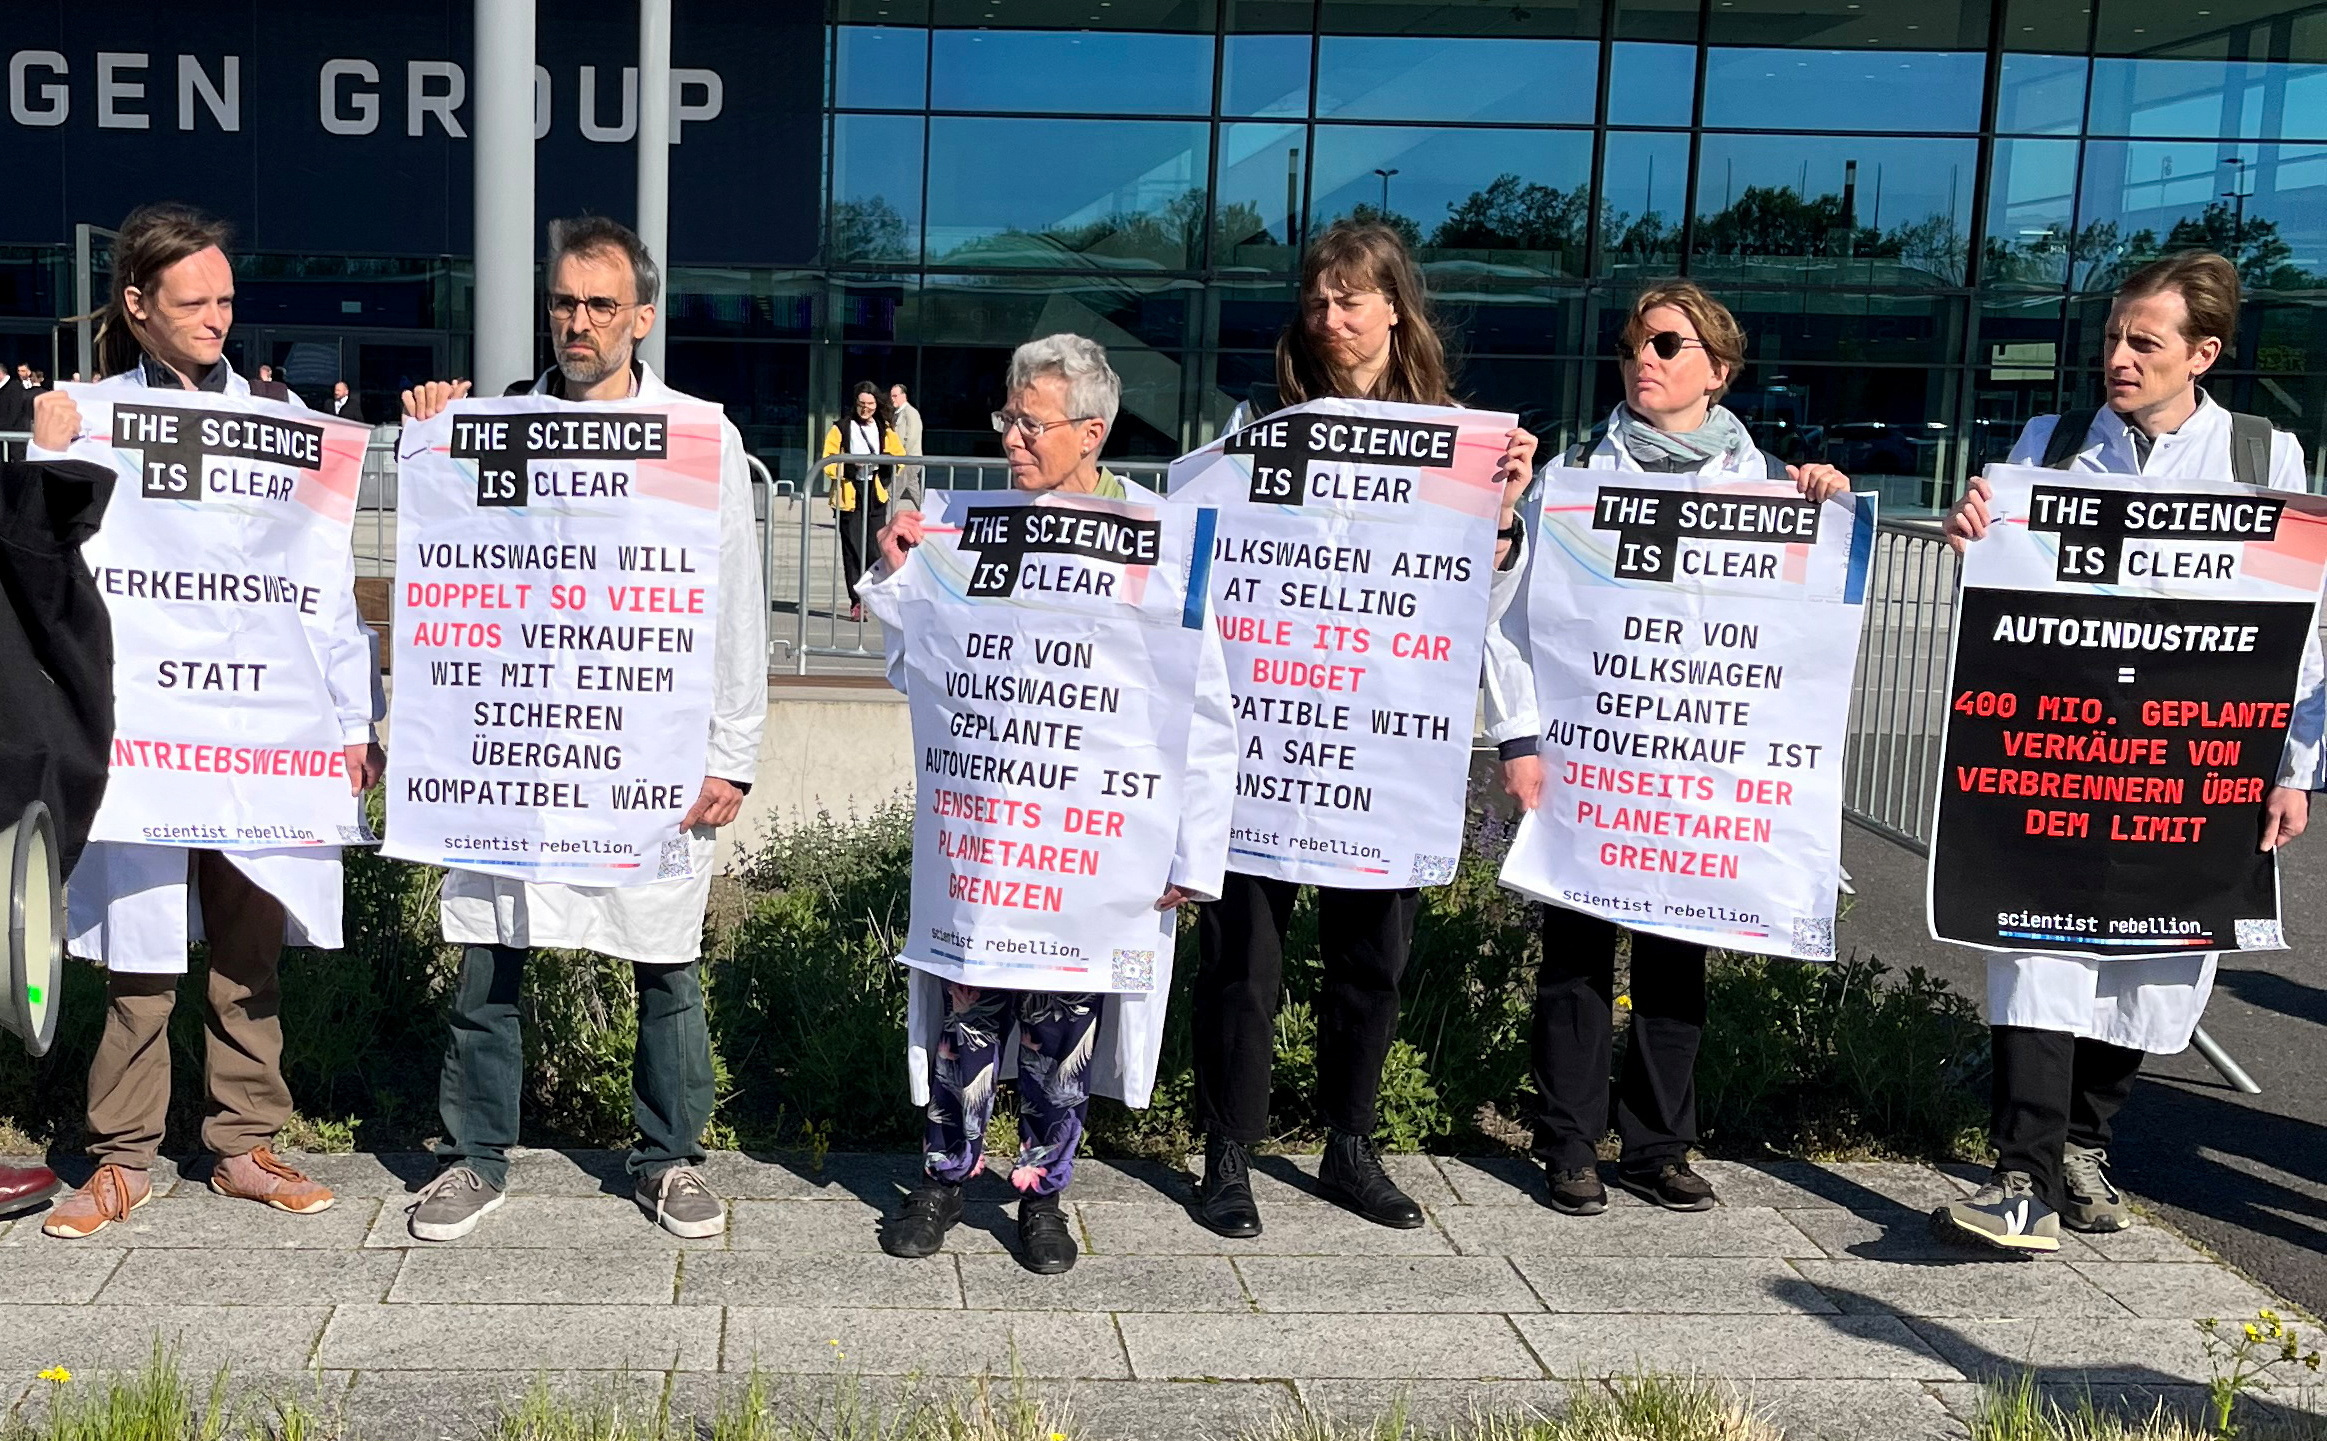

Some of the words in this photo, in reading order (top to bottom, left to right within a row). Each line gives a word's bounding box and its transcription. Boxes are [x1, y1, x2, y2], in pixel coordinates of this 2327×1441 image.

[10, 51, 239, 131] GEN
[117, 412, 178, 443] THE
[202, 419, 318, 462] SCIENCE
[457, 423, 508, 450] THE
[527, 422, 662, 450] SCIENCE
[1234, 421, 1288, 449] THE
[1309, 423, 1451, 458] SCIENCE
[148, 462, 187, 491] IS
[210, 468, 293, 501] CLEAR
[483, 471, 515, 498] IS
[535, 472, 628, 496] CLEAR
[1255, 468, 1291, 495] IS
[1312, 473, 1411, 503] CLEAR
[1602, 496, 1659, 524] THE
[1679, 502, 1815, 535] SCIENCE
[2036, 495, 2101, 525] THE
[2125, 502, 2276, 532] SCIENCE
[969, 517, 1009, 543] THE
[1026, 515, 1155, 558] SCIENCE
[419, 544, 596, 569] VOLKSWAGEN
[619, 546, 695, 572] WILL
[1215, 538, 1370, 573] LKSWAGEN
[1392, 552, 1471, 581] AIMS
[1621, 544, 1661, 572] IS
[1683, 550, 1777, 579] CLEAR
[2063, 546, 2105, 574] IS
[2129, 551, 2234, 579] CLEAR
[95, 566, 321, 616] ERKEHRSWEE
[408, 583, 531, 608] DOPPELT
[551, 585, 585, 610] SO
[608, 586, 704, 613] VIELE
[974, 564, 1008, 589] IS
[1022, 564, 1114, 596] CLEAR
[1224, 578, 1261, 602] AT
[1280, 582, 1416, 617] SELLING
[414, 623, 501, 648] AUTOS
[521, 624, 692, 652] VERKAUFEN
[967, 633, 1013, 660] DER
[1035, 639, 1092, 668] VON
[1216, 615, 1292, 645] UBLE
[1314, 625, 1370, 653] ITS
[1393, 633, 1451, 661] CAR
[1624, 616, 1683, 644] DER
[1704, 623, 1758, 649] VON
[1993, 615, 2258, 651] AUTOINDUSTRIE
[158, 661, 266, 691] STATT
[432, 662, 481, 686] WIE
[502, 663, 555, 688] MIT
[578, 666, 673, 692] EINEM
[1253, 658, 1365, 692] BUDGET
[1593, 652, 1782, 689] VOLKSWAGEN
[946, 671, 1119, 712] VOLKSWAGEN
[1597, 692, 1749, 726] GEPLANTE
[1955, 691, 2016, 718] 400
[2037, 696, 2116, 724] MIO.
[2143, 701, 2290, 728] GEPLANTE
[474, 702, 622, 730] SICHEREN
[951, 712, 1082, 750] GEPLANTE
[1372, 710, 1449, 741] WITH
[109, 739, 344, 777] NTRIEBSWENDE
[473, 734, 621, 770] ÜBERGANG
[1246, 736, 1263, 760] A
[1283, 740, 1356, 770] SAFE
[1546, 719, 1745, 763] AUTOVERKAUF
[1768, 743, 1822, 768] IST
[2003, 730, 2167, 764] VERKÄUFE
[2189, 741, 2241, 766] VON
[925, 747, 1078, 790] AUTOVERKAUF
[1102, 770, 1161, 798] IST
[1563, 761, 1713, 800] JENSEITS
[1736, 779, 1792, 805] DER
[1958, 767, 2184, 804] VERBRENNERN
[2203, 772, 2263, 804] ÜBER
[408, 778, 588, 808] KOMPATIBEL
[612, 779, 683, 809] WÄRE
[931, 786, 1041, 832] JENSEITS
[1064, 808, 1124, 837] DER
[143, 825, 227, 838] scientist
[1578, 801, 1770, 842] PLANETAREN
[2026, 810, 2089, 838] DEM
[2111, 815, 2206, 842] LIMIT
[445, 837, 528, 851] scientist
[938, 829, 1099, 876] PLANETAREN
[1601, 843, 1738, 878] GRENZEN
[949, 873, 1063, 912] GRENZEN
[1564, 891, 1652, 912] scientist
[932, 928, 972, 949] scientist
[1998, 910, 2098, 932] scientist
